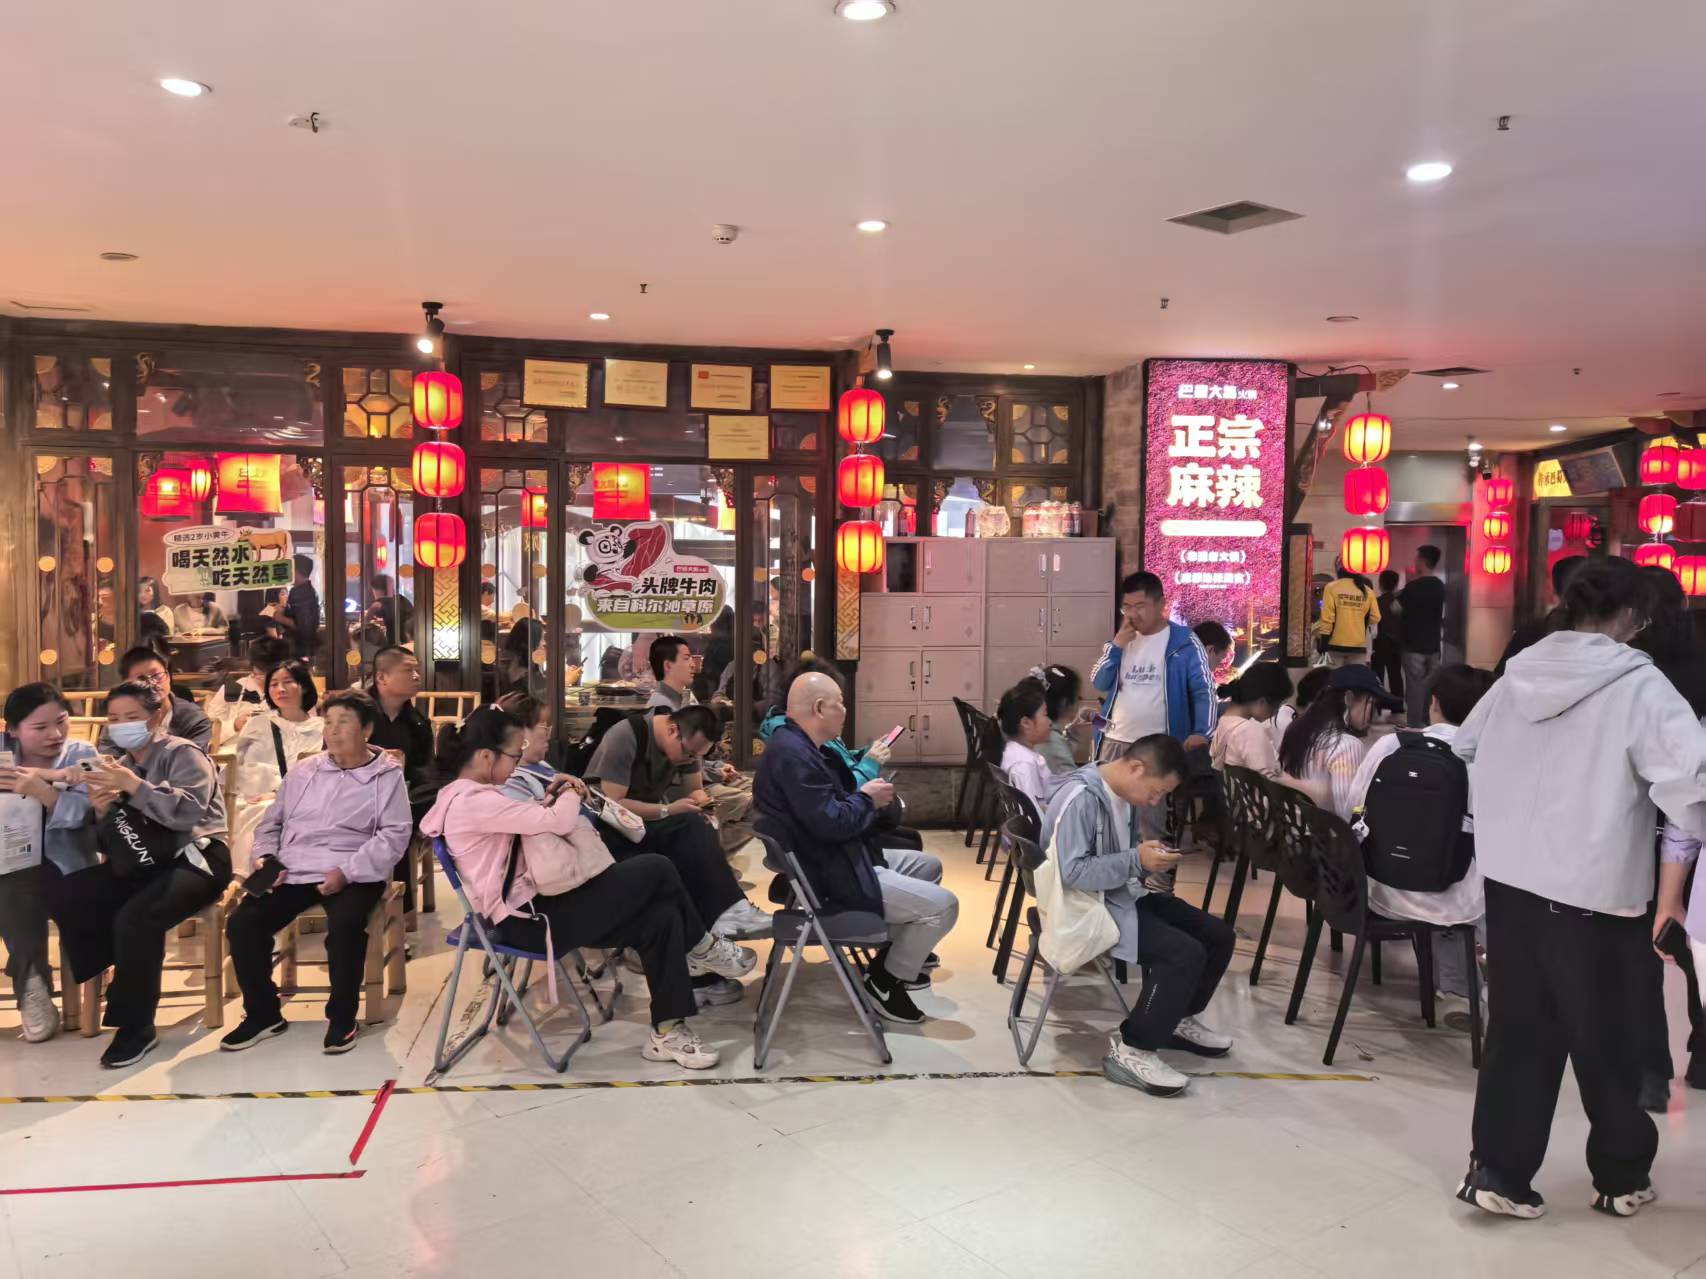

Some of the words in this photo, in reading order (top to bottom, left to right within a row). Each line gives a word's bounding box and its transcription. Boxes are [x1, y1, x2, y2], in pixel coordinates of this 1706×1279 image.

[1168, 414, 1264, 459] 正宗
[1166, 462, 1264, 508] 麻辣
[172, 545, 249, 568] 喝天然水
[212, 563, 289, 587] 吃天然草
[641, 577, 717, 595] 头牌牛肉
[597, 599, 714, 614] 来自科尔沁草原
